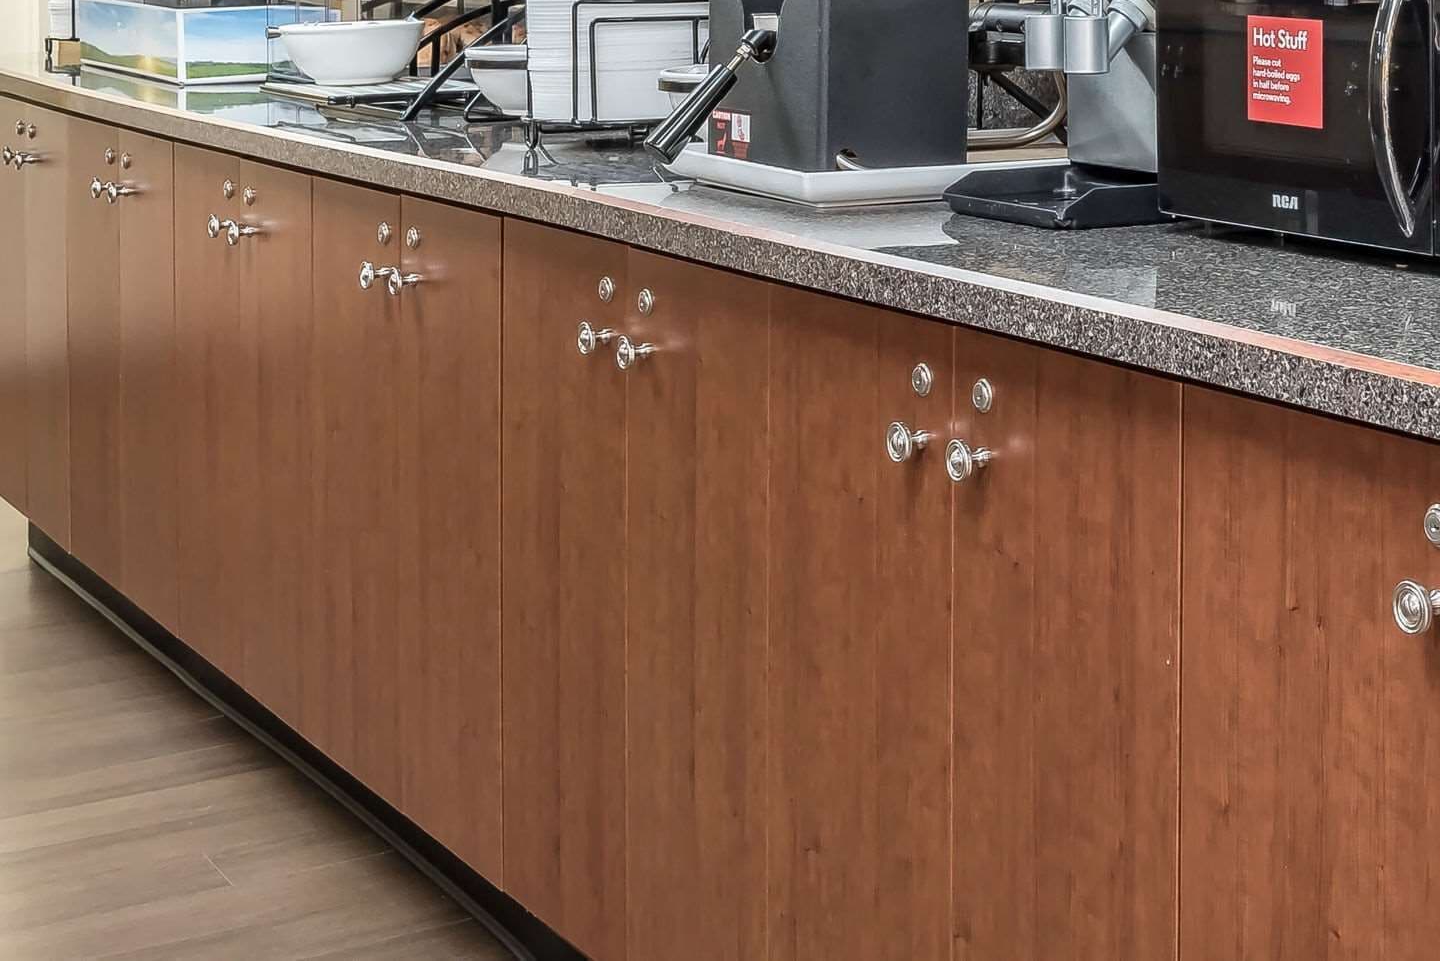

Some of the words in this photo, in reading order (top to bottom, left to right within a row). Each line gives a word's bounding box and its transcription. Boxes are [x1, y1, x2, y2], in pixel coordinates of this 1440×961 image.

[1253, 27, 1275, 47] Hot
[1277, 28, 1309, 51] Stuff
[1253, 55, 1271, 66] Please
[1272, 58, 1281, 67] cut
[1253, 69, 1285, 79] hard-boiled
[1286, 72, 1300, 83] eggs
[1253, 79, 1258, 88] in
[1259, 80, 1270, 90] half
[1271, 81, 1290, 91] before
[1253, 91, 1291, 104] microwaving.
[1272, 194, 1298, 209] RCA
